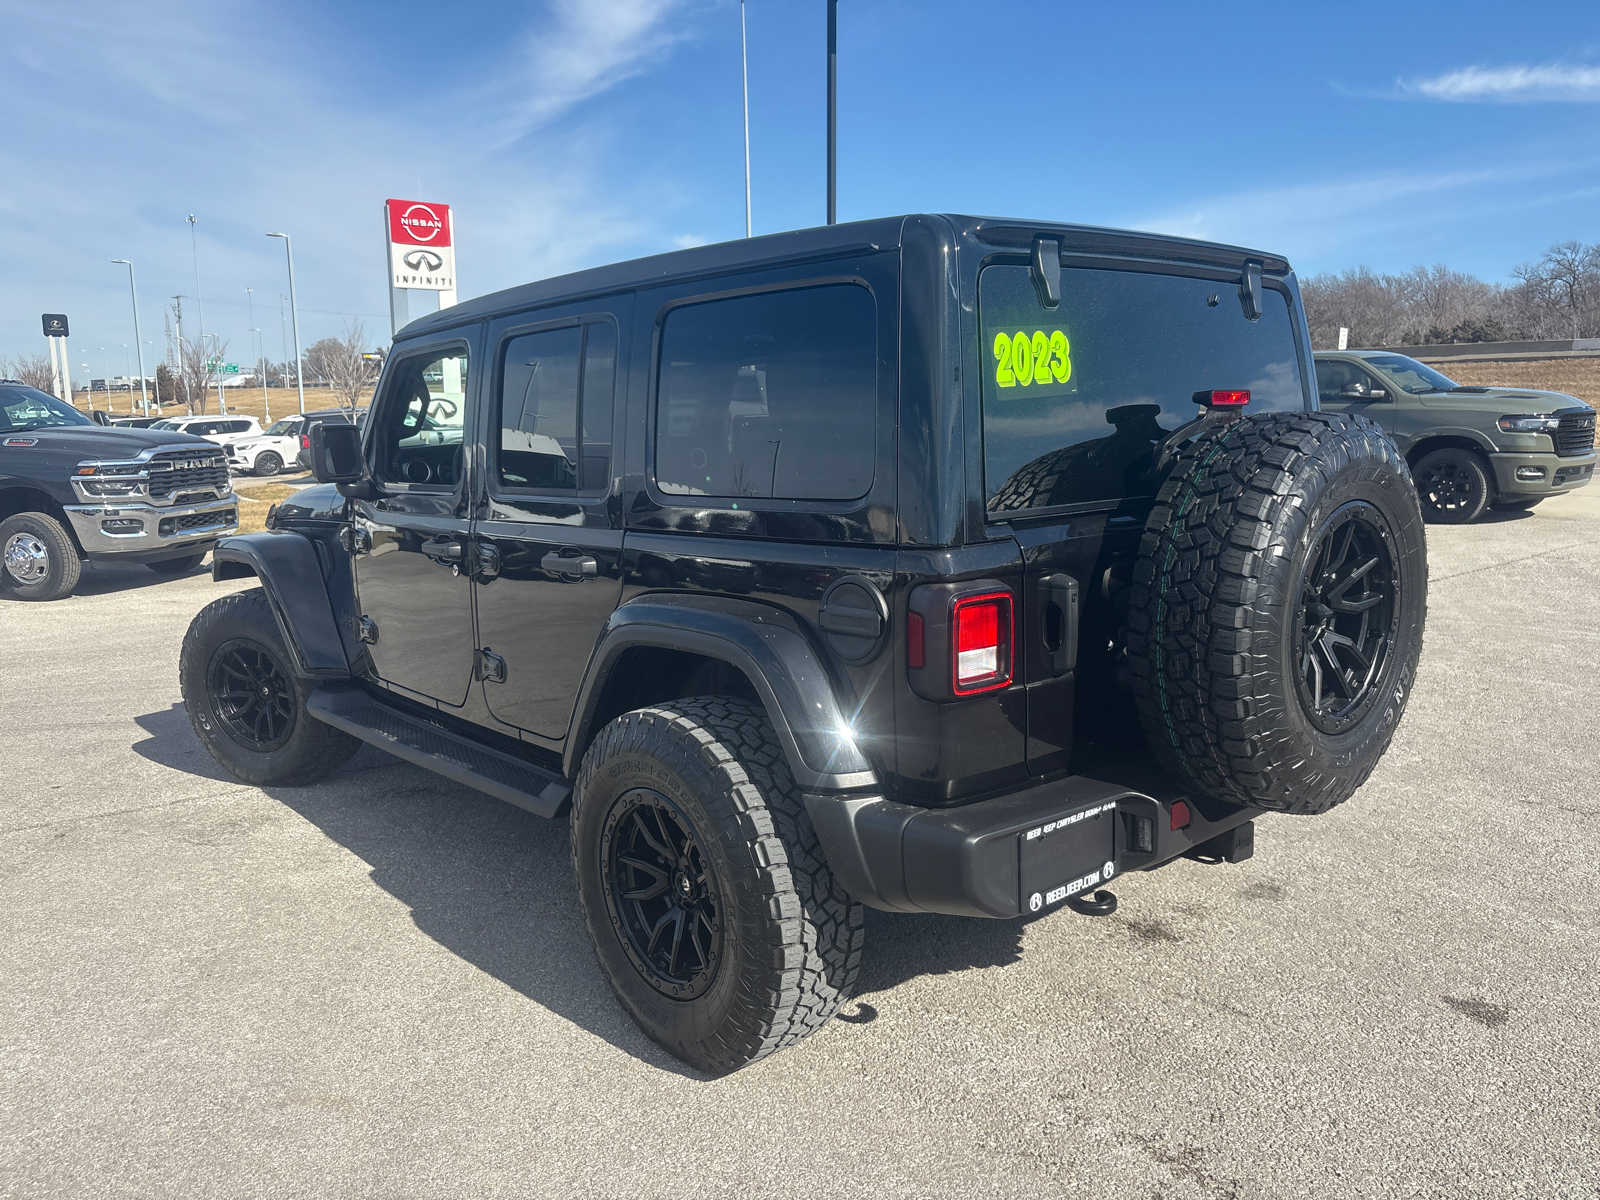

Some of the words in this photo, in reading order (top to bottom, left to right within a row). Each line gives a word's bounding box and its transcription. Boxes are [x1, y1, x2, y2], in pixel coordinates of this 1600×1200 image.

[401, 217, 442, 229] NISSAN
[396, 275, 452, 286] INFINITI
[993, 330, 1072, 387] 2023
[173, 457, 216, 470] RAM
[1026, 827, 1042, 841] REED
[1056, 811, 1085, 829] CHRYSLER
[1102, 800, 1116, 811] RAM
[1046, 870, 1100, 905] REEDJEEP.COM
